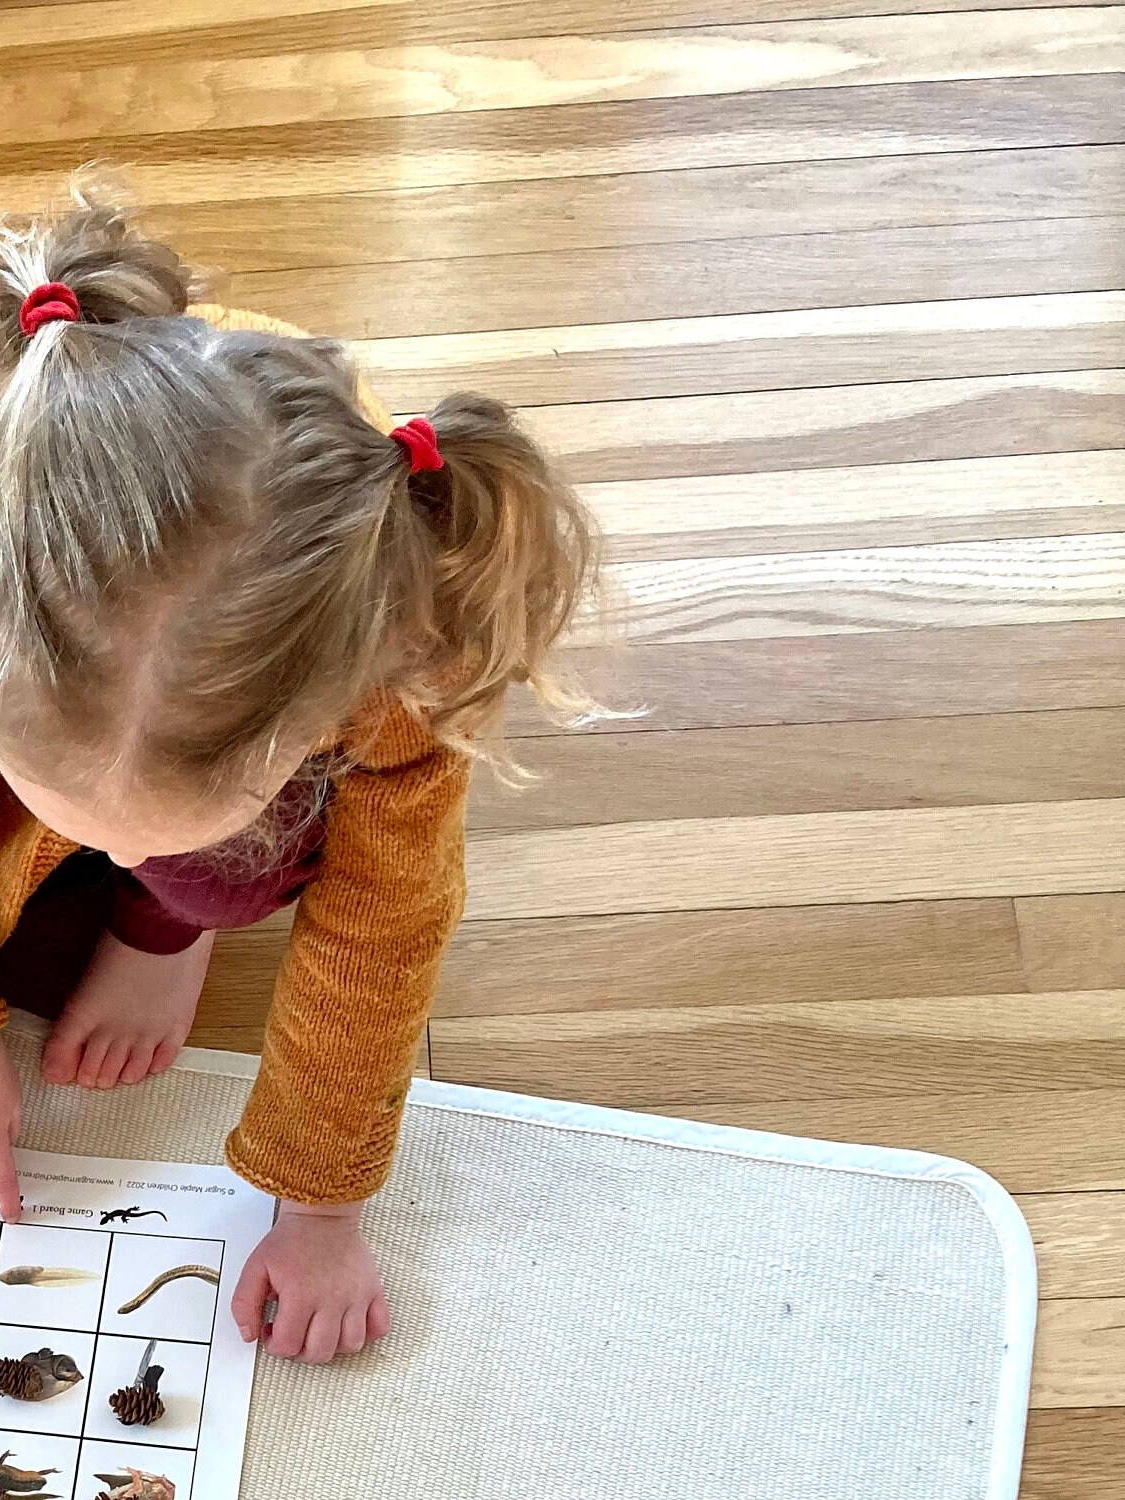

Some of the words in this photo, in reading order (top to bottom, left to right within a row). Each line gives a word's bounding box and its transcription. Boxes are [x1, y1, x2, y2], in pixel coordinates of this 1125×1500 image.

[15, 1169, 115, 1187] www.sugarmaplechildren.c
[126, 1180, 146, 1189] 2022
[147, 1182, 178, 1192] Children
[180, 1184, 203, 1194] Maple
[204, 1187, 226, 1196] Sugar
[38, 1205, 65, 1215] Board
[67, 1207, 94, 1218] Game
